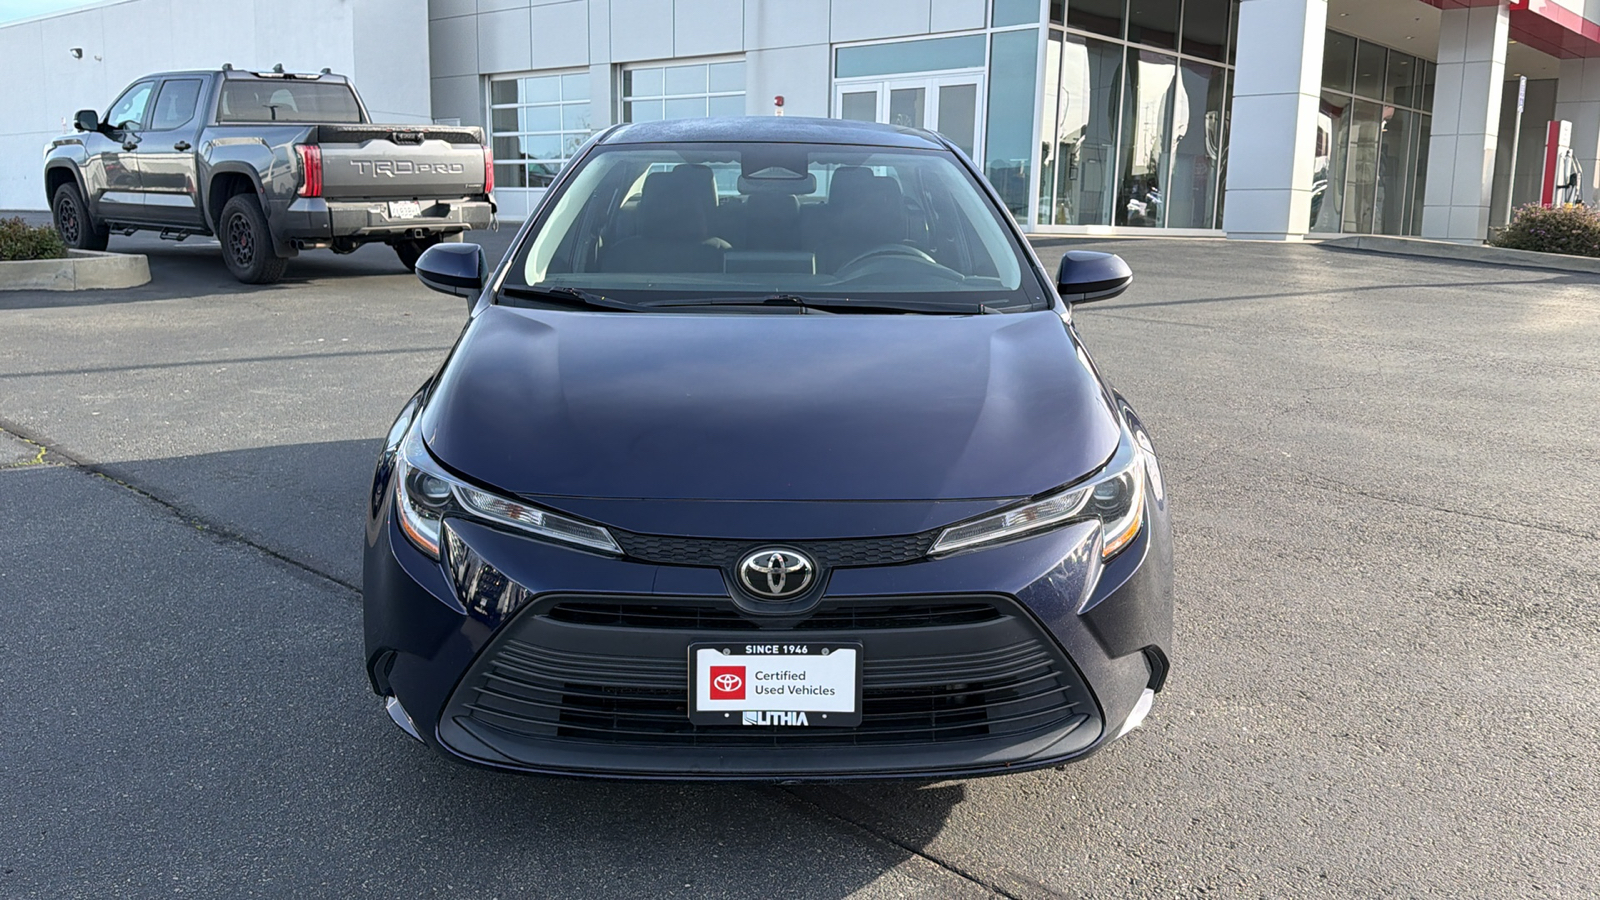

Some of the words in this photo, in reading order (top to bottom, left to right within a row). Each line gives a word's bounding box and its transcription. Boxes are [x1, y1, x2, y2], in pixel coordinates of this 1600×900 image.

[350, 160, 414, 178] TRD
[415, 163, 464, 174] PRO
[745, 645, 779, 654] SINCE
[783, 645, 808, 654] 1946
[755, 670, 806, 681] Certified
[755, 685, 784, 695] Used
[787, 685, 836, 696] Vehicles
[757, 711, 809, 726] LITHIA
